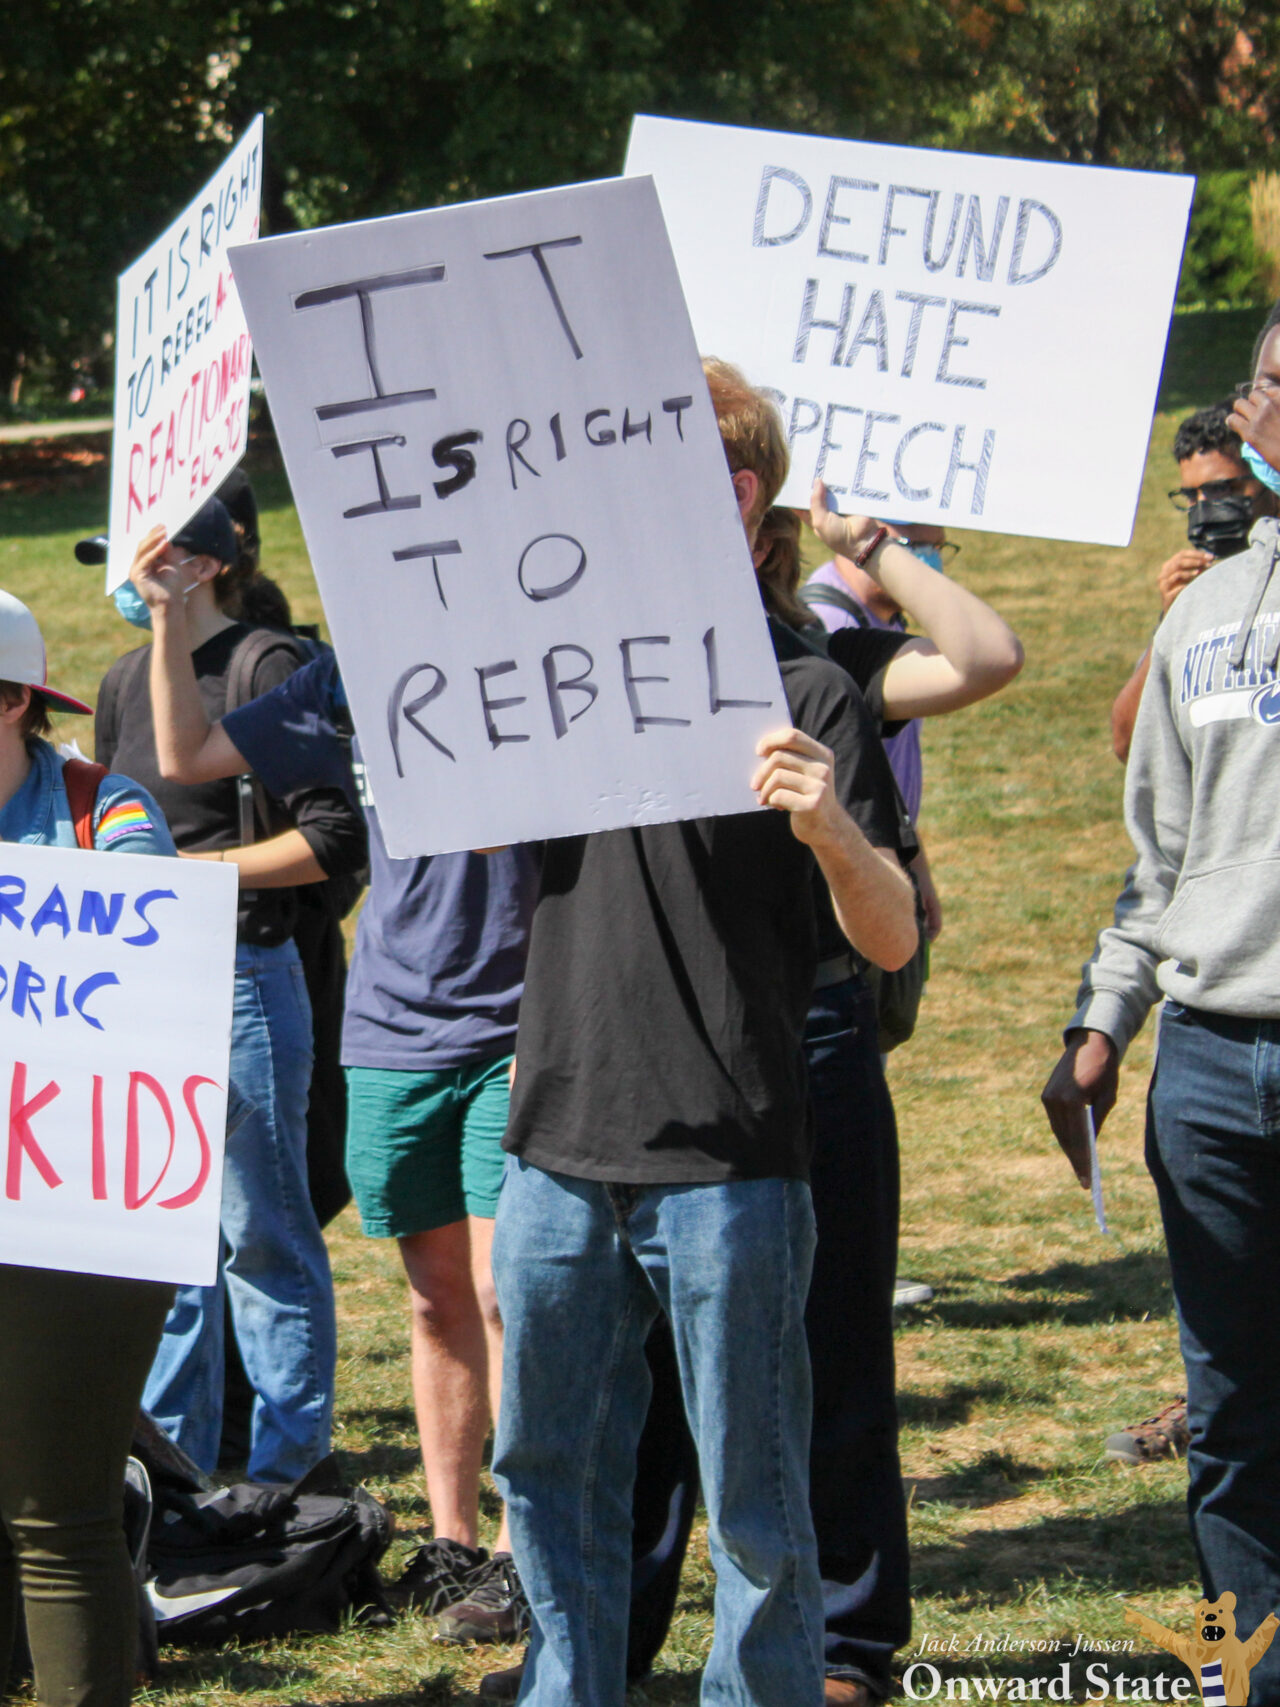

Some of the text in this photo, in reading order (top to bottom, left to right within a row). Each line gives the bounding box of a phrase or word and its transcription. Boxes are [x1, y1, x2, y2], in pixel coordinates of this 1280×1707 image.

[132, 267, 158, 360] IT
[166, 226, 190, 313] IS
[199, 142, 259, 268] RIGHT
[752, 165, 1063, 286] DEFUND
[127, 292, 213, 431] TO REBEL
[292, 236, 583, 421] IT
[792, 278, 1002, 390] HATE
[330, 430, 484, 519] IS
[506, 395, 693, 490] RIGHT
[754, 386, 996, 515] PEECH
[392, 533, 587, 611] TO
[386, 626, 773, 779] REBEL
[5, 1060, 225, 1211] KIDS
